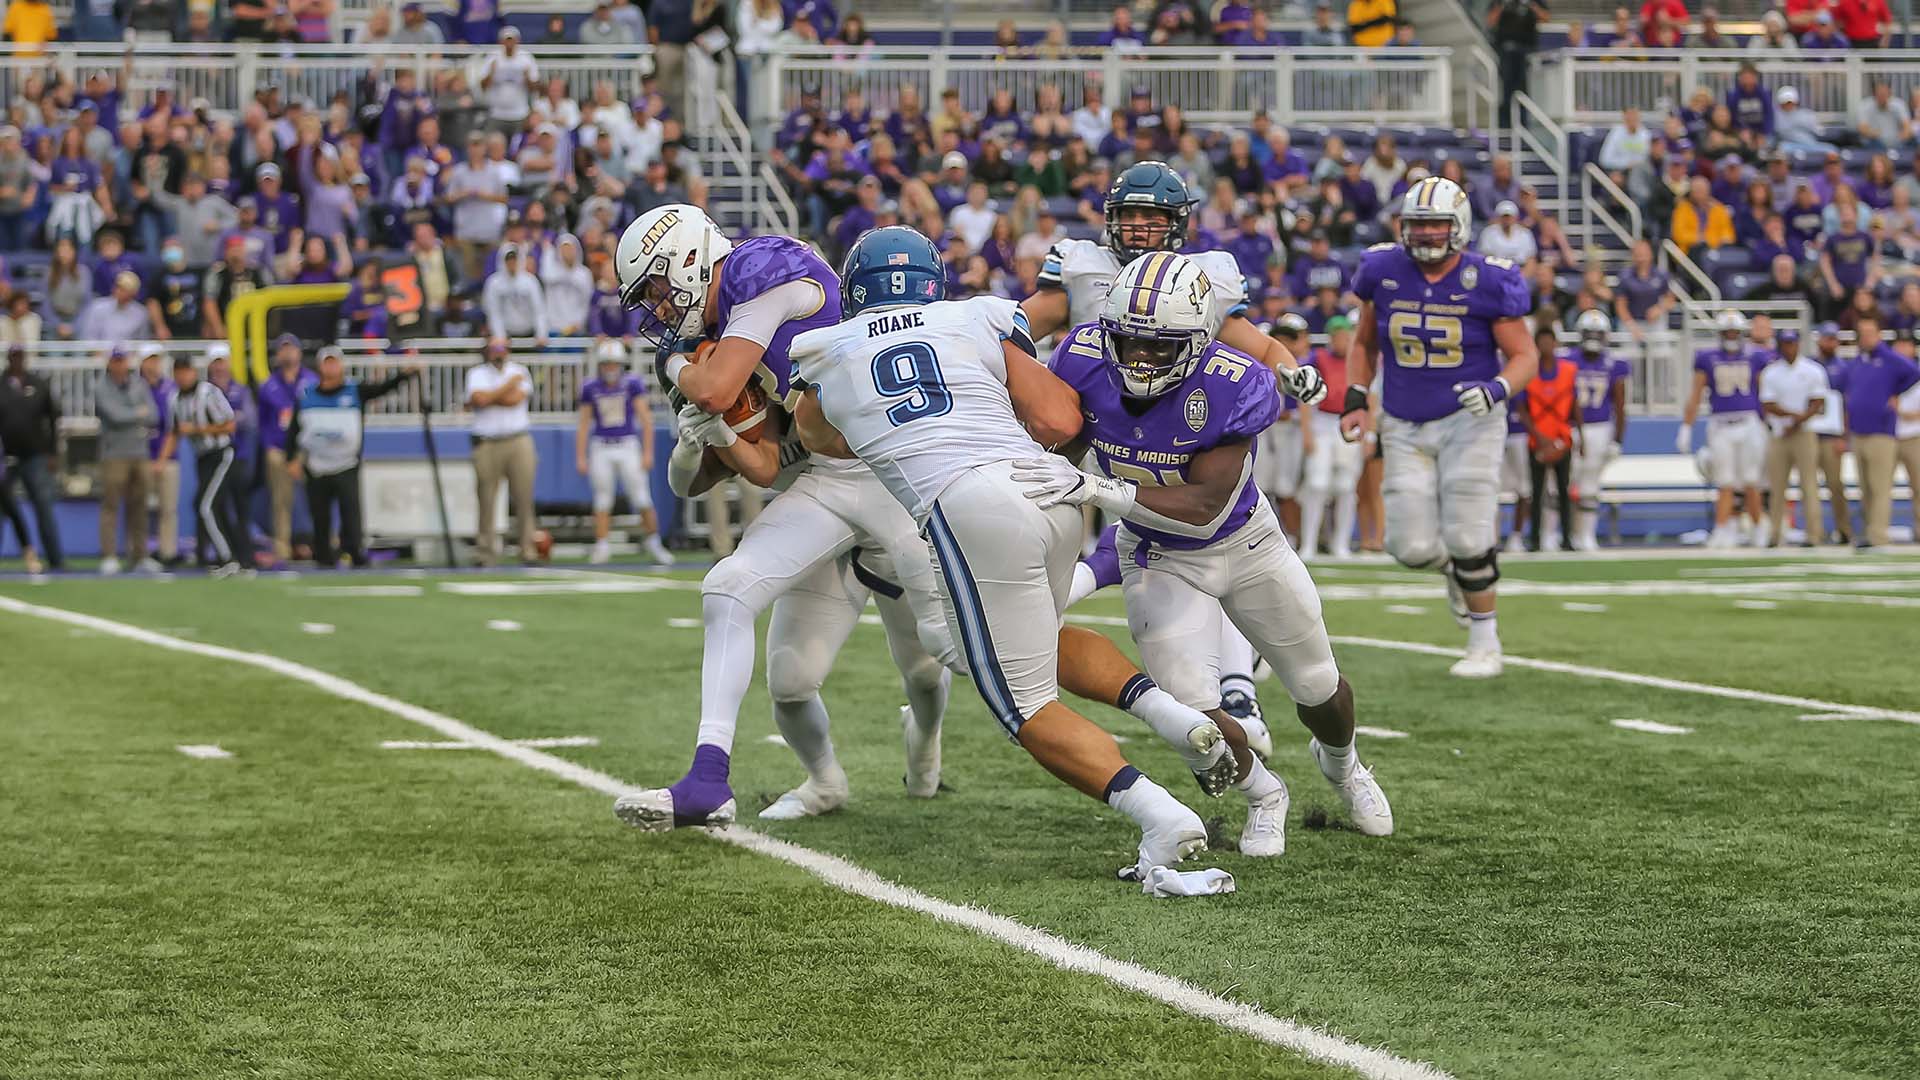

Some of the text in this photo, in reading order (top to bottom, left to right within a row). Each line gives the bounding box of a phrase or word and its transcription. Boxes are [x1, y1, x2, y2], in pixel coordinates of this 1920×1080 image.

[641, 212, 679, 256] JMU
[382, 265, 421, 315] 3
[891, 271, 906, 295] 9
[867, 312, 924, 338] RUANE
[1388, 312, 1465, 369] 63
[871, 341, 954, 428] 9
[1203, 348, 1253, 384] 31
[1091, 438, 1190, 465] JAMES MADISO
